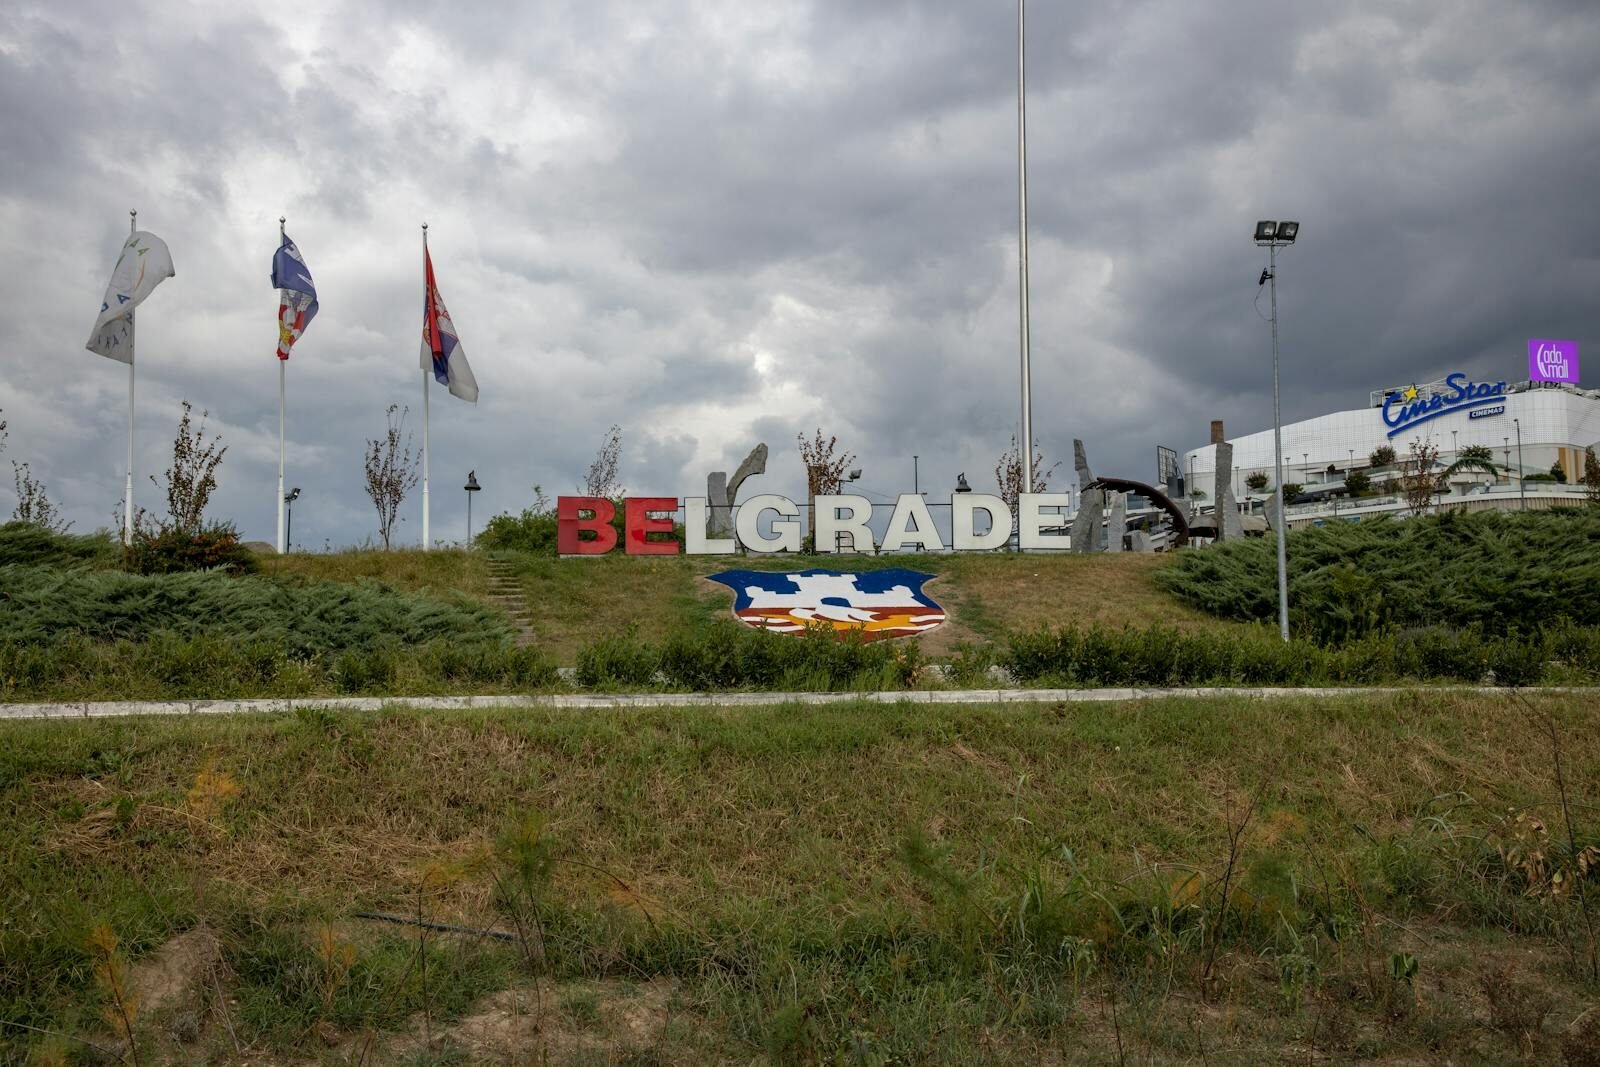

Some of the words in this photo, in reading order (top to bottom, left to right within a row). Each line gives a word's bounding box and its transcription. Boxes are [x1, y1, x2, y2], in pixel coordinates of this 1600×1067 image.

[1547, 359, 1569, 379] mall
[1471, 406, 1504, 418] CINEMAS
[557, 493, 1071, 555] BELGRADE
